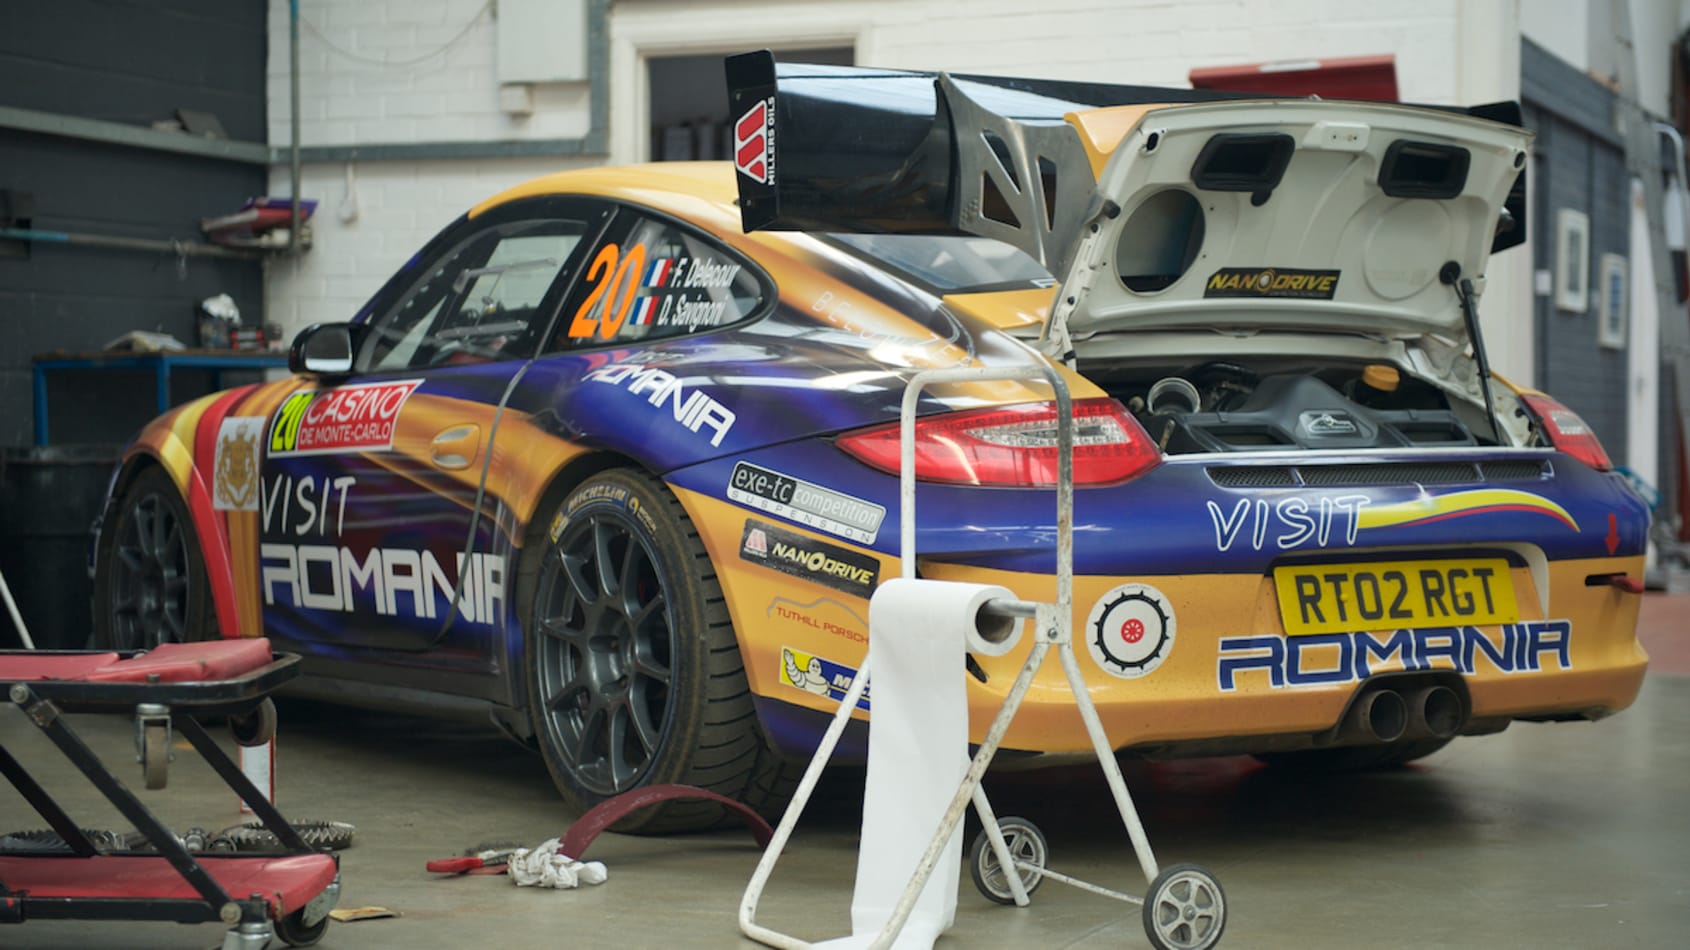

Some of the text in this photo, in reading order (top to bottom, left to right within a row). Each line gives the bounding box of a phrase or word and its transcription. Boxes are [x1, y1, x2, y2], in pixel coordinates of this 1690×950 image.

[767, 96, 776, 186] MILLERS OILS
[568, 242, 646, 340] 20
[684, 257, 742, 288] Delecour
[1209, 268, 1337, 292] NANODRIVE
[671, 295, 729, 333] Savignoni
[271, 387, 406, 451] 20 CASINO
[300, 421, 391, 444] DE MONTE-CARLO
[260, 473, 356, 537] VISIT
[731, 490, 871, 543] SUSPENSION
[735, 468, 878, 527] exe-tc competition
[1207, 495, 1370, 551] VISIT
[260, 543, 506, 629] ROMANIA
[772, 542, 875, 585] NANODRIVE
[1294, 567, 1496, 625] RT02 RGT
[776, 606, 869, 645] TUTHILL PORSCH
[1217, 619, 1572, 692] ROMANIA
